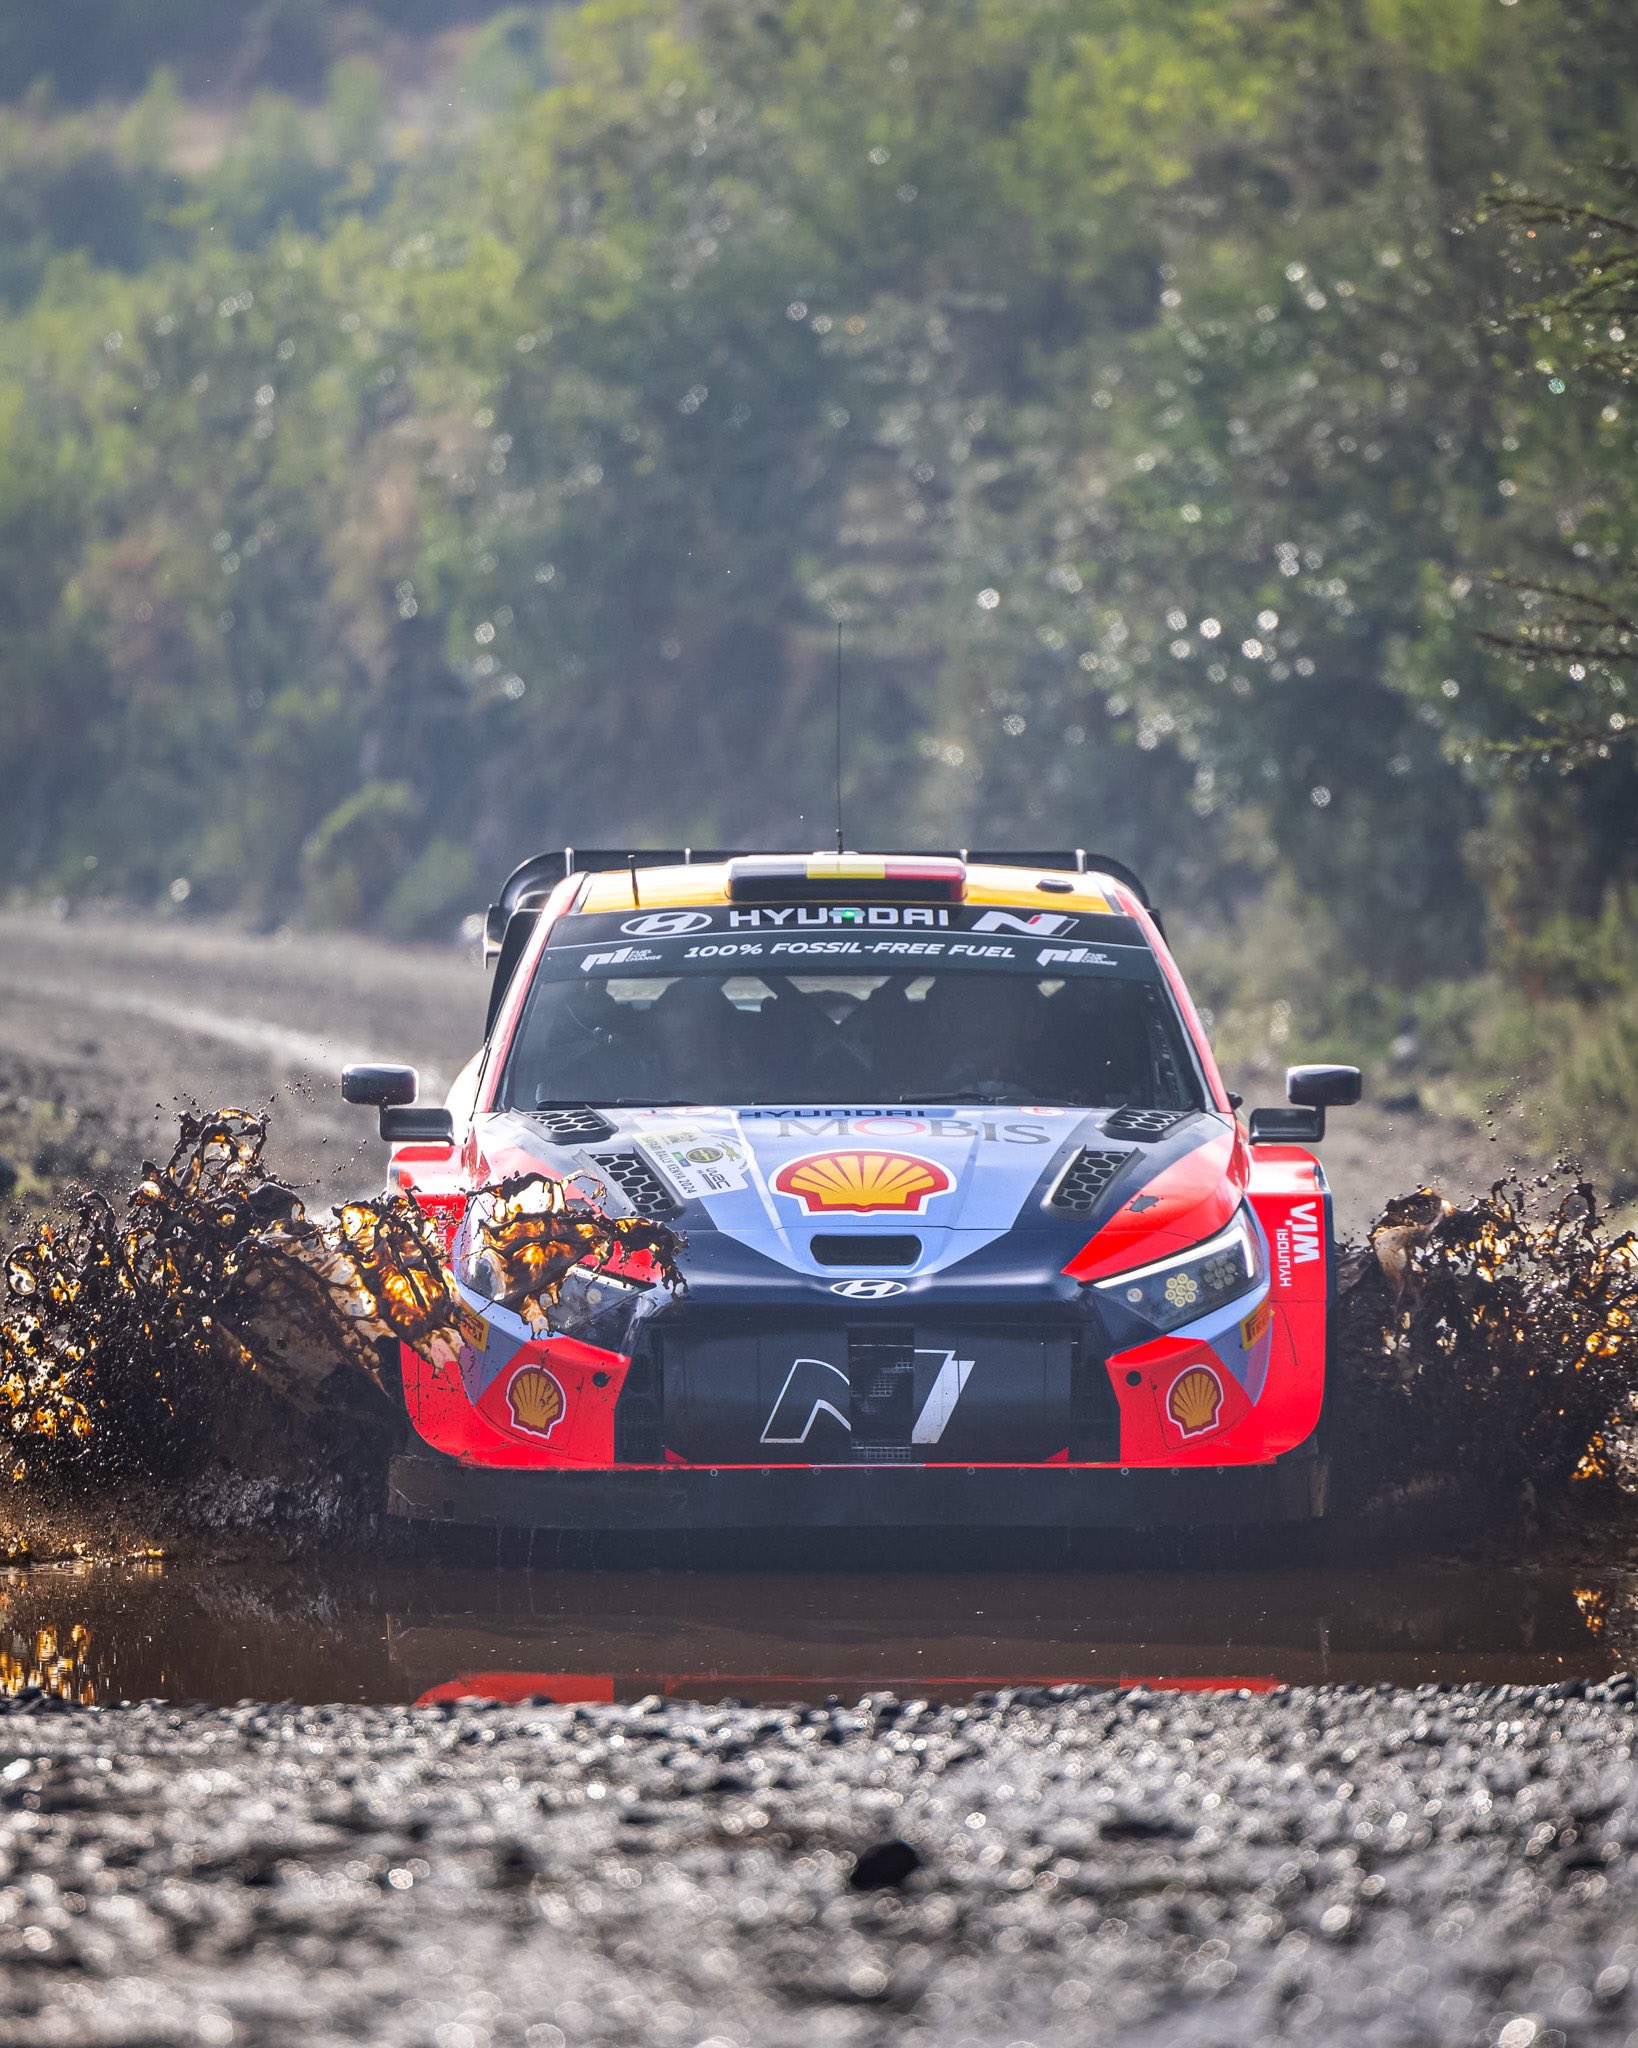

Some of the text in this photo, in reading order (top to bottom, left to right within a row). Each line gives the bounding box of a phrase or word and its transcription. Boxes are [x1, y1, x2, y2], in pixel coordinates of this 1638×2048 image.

[729, 907, 949, 927] HYUNDAI
[684, 941, 1016, 959] 100% FOSSIL-FREE FUEL
[739, 1109, 926, 1119] HYUNDAI
[777, 1118, 1052, 1145] MOBIS
[655, 1149, 675, 1164] RALLY
[667, 1162, 687, 1180] KENYA
[679, 1178, 698, 1195] 2024
[1276, 1228, 1292, 1287] HYUNDAI
